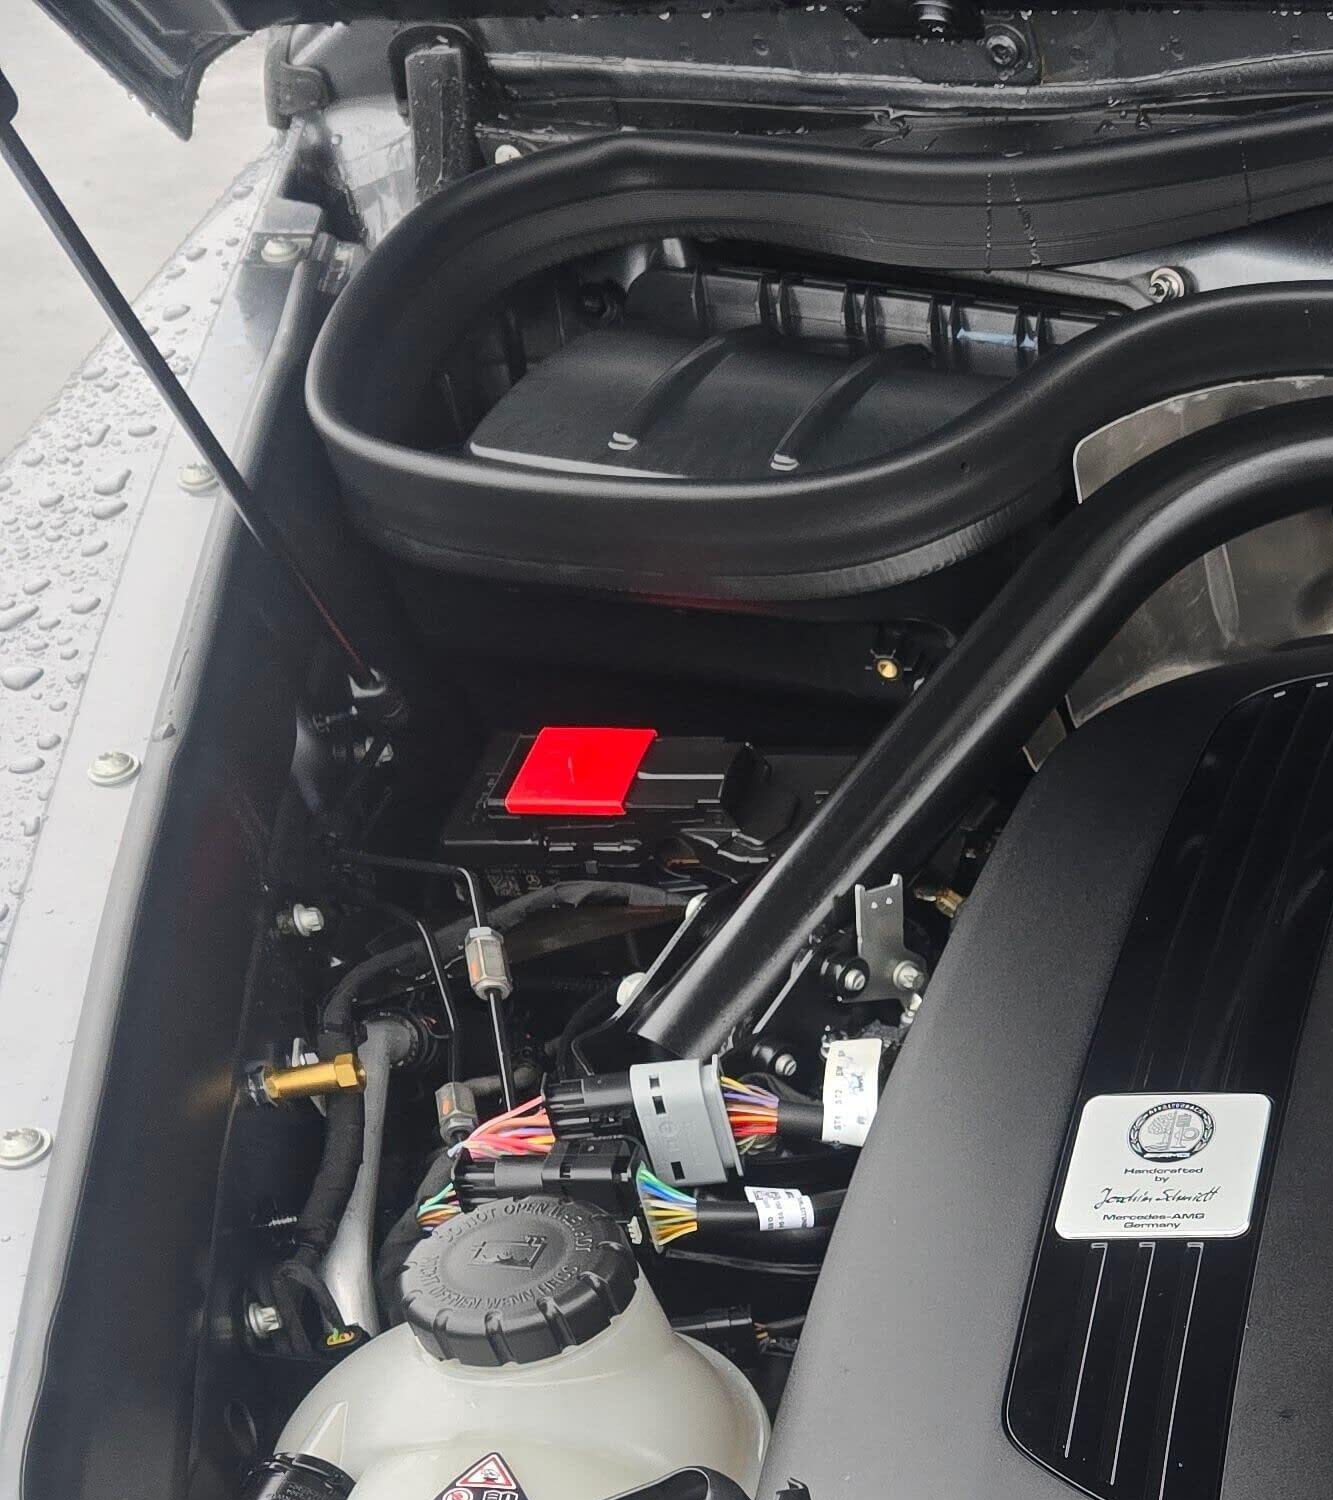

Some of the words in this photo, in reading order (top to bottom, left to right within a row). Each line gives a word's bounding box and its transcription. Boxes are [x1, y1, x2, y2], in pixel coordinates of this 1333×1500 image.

[1123, 1167, 1204, 1175] Handcrafted
[1154, 1175, 1170, 1183] by
[503, 1202, 548, 1215] OPEN
[1102, 1212, 1206, 1222] Mercedes-AMG
[1123, 1221, 1181, 1230] Germany
